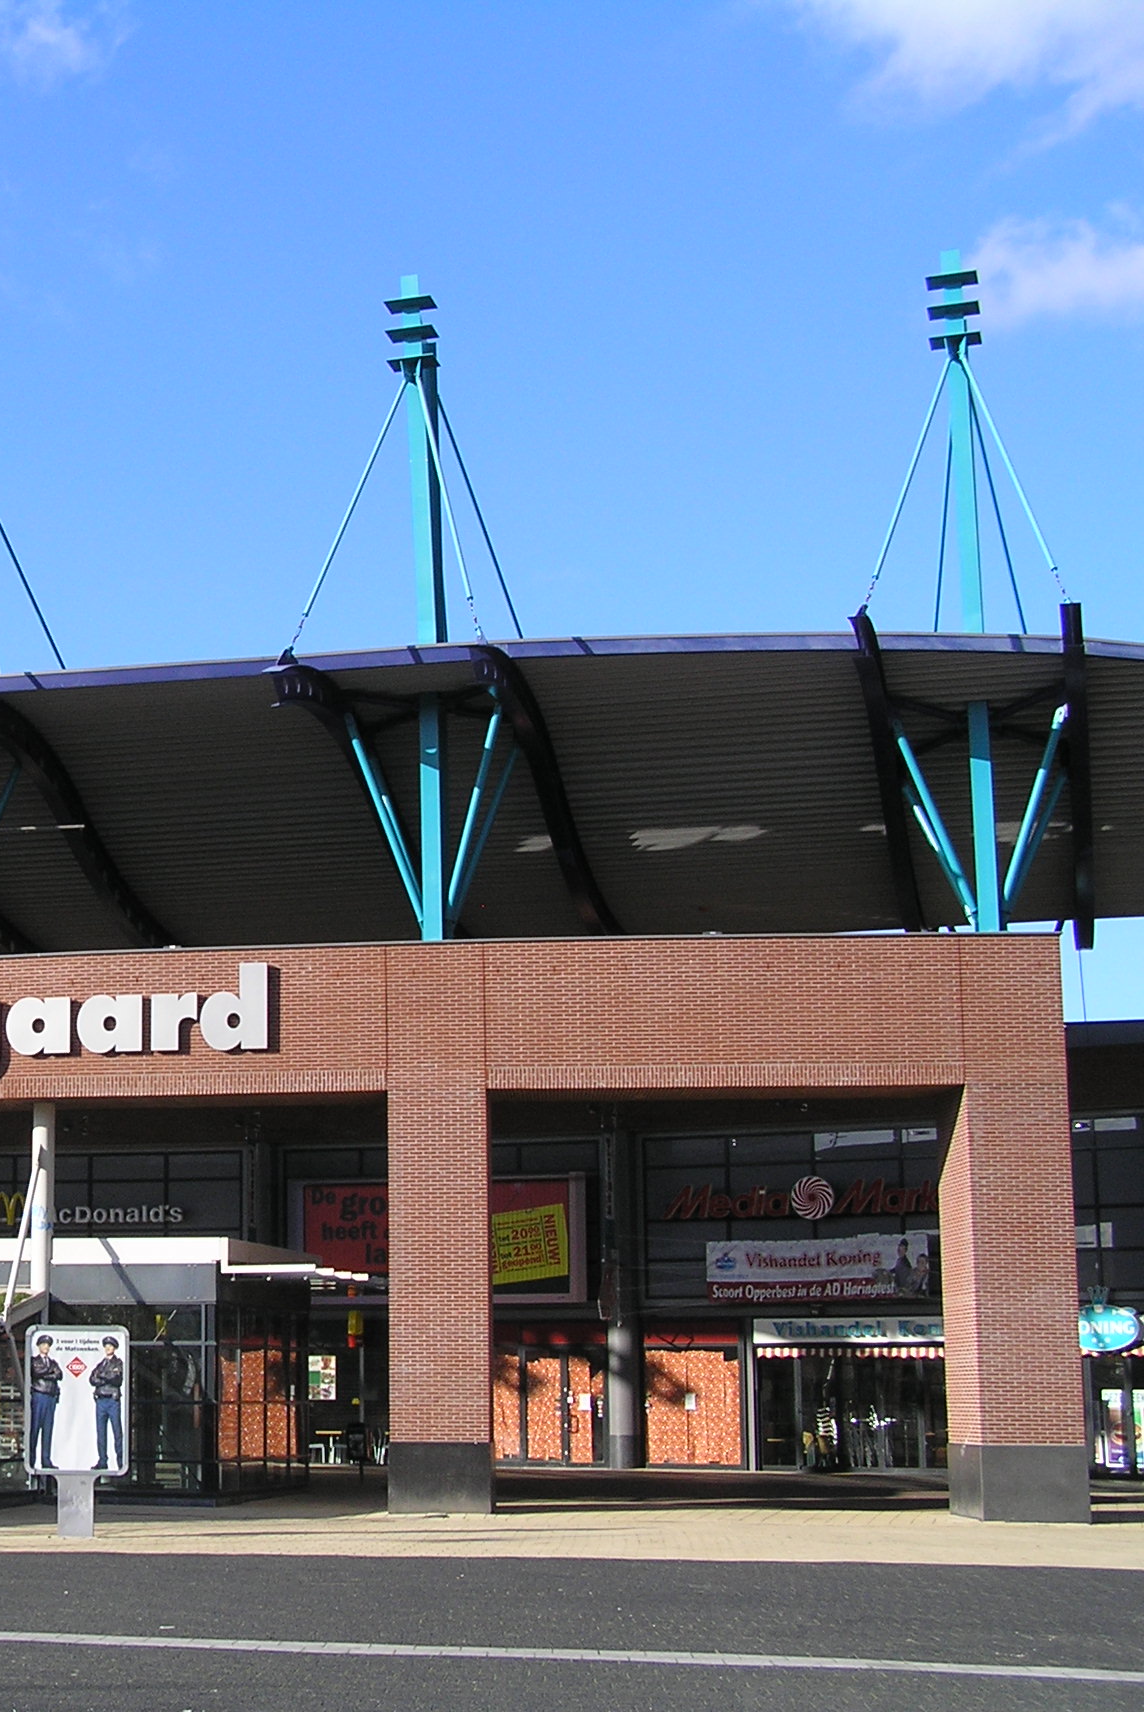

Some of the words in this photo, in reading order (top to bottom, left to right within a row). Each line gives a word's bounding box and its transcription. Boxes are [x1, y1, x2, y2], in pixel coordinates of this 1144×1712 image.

[340, 1193, 387, 1222] gro
[664, 1184, 790, 1219] Media
[832, 1178, 939, 1215] Mark
[57, 1204, 184, 1224] cDonald's
[364, 1244, 387, 1265] la
[745, 1252, 821, 1268] Vishandel
[826, 1250, 881, 1267] Koning
[712, 1283, 743, 1299] Scoort
[745, 1284, 797, 1301] Opperbest
[797, 1283, 807, 1297] in
[809, 1283, 821, 1297] de
[824, 1282, 841, 1297] AD
[843, 1280, 895, 1297] Haringtest
[772, 1320, 884, 1338] Vishandel
[897, 1320, 942, 1337] Kon
[1078, 1320, 1135, 1335] ONING
